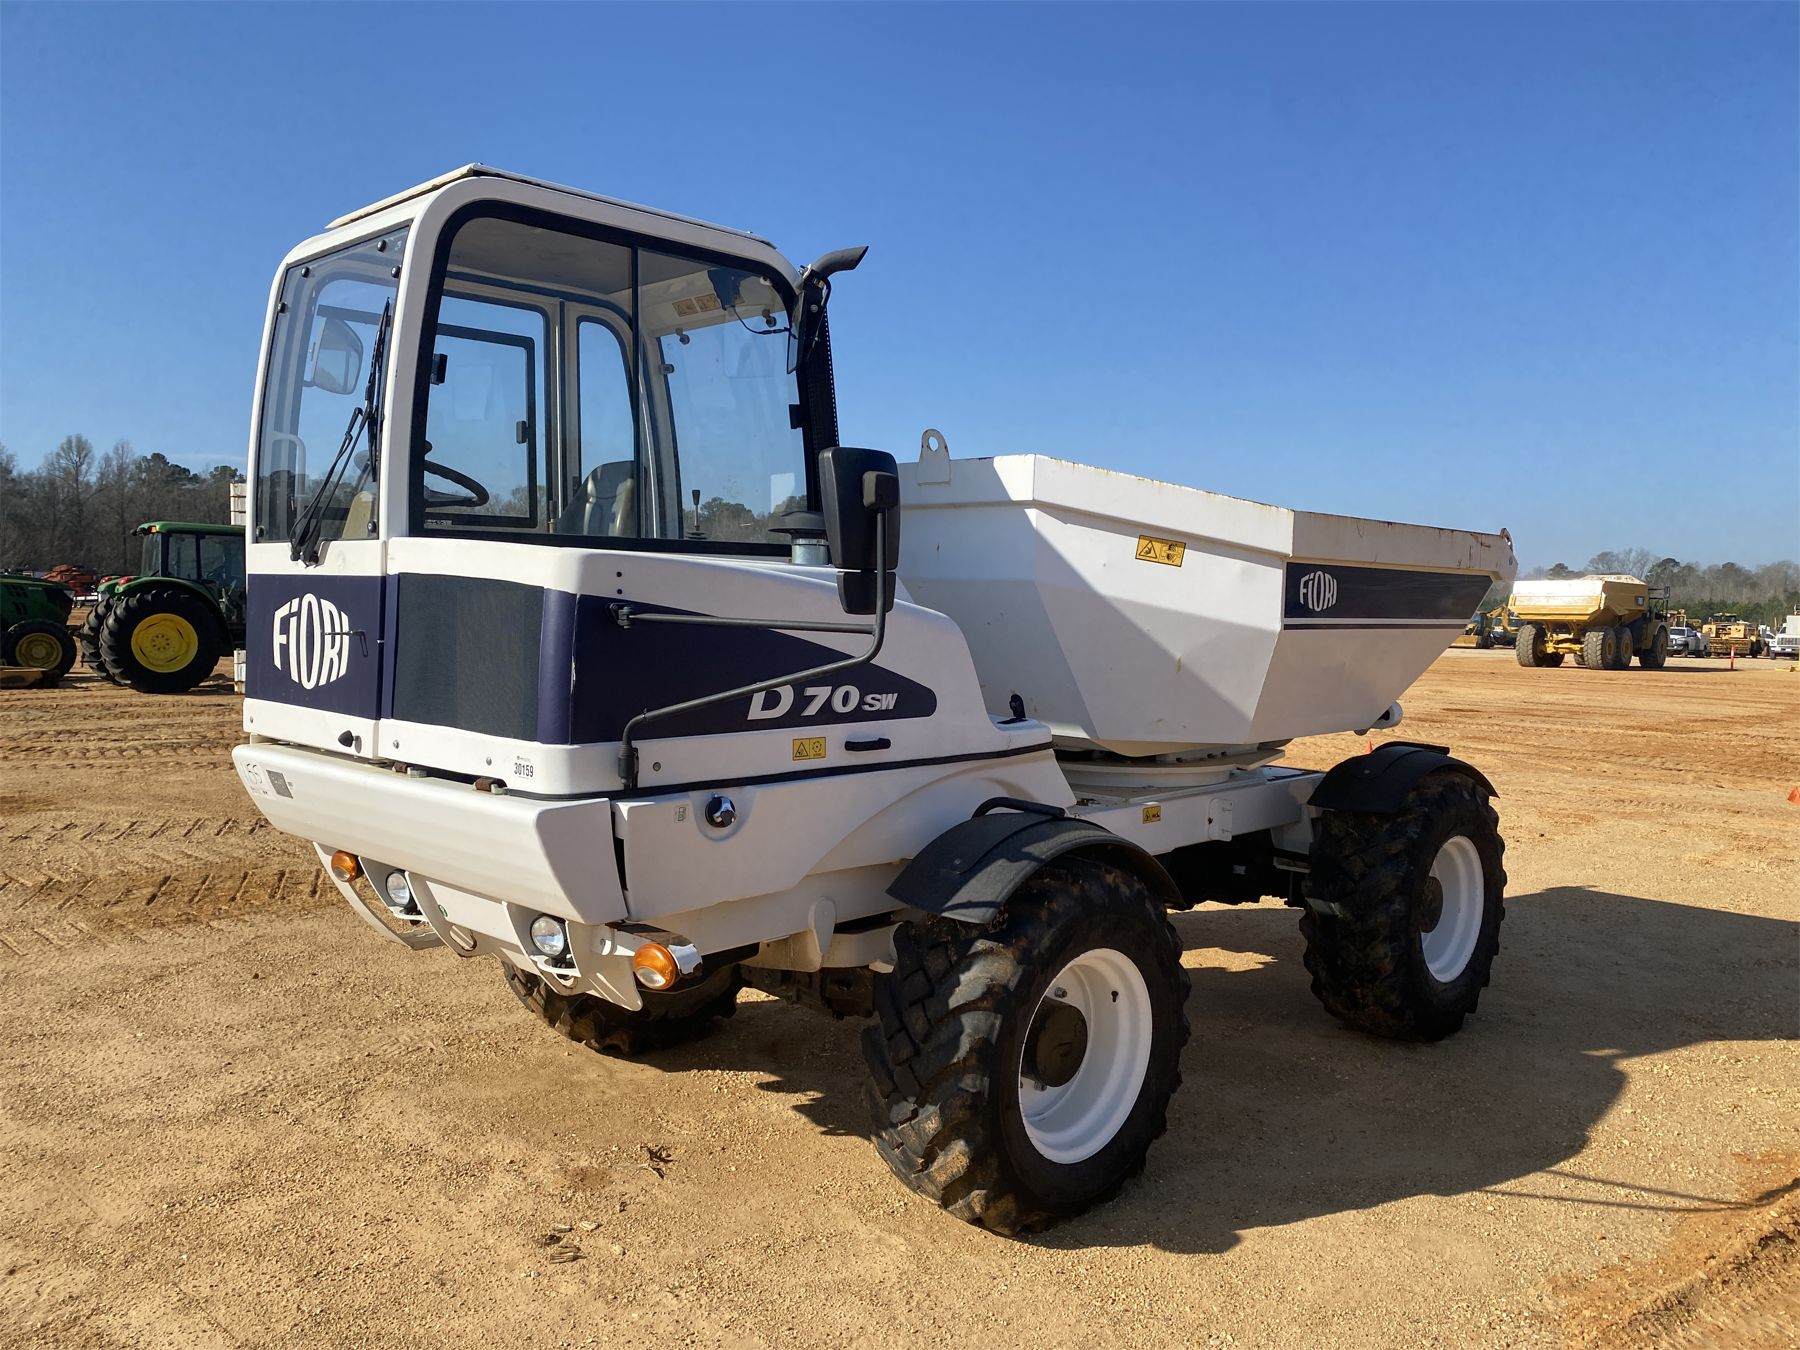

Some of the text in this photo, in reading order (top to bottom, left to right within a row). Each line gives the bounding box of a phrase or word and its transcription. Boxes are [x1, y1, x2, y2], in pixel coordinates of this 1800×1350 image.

[747, 684, 898, 721] D 70 SW
[513, 762, 534, 778] 30159
